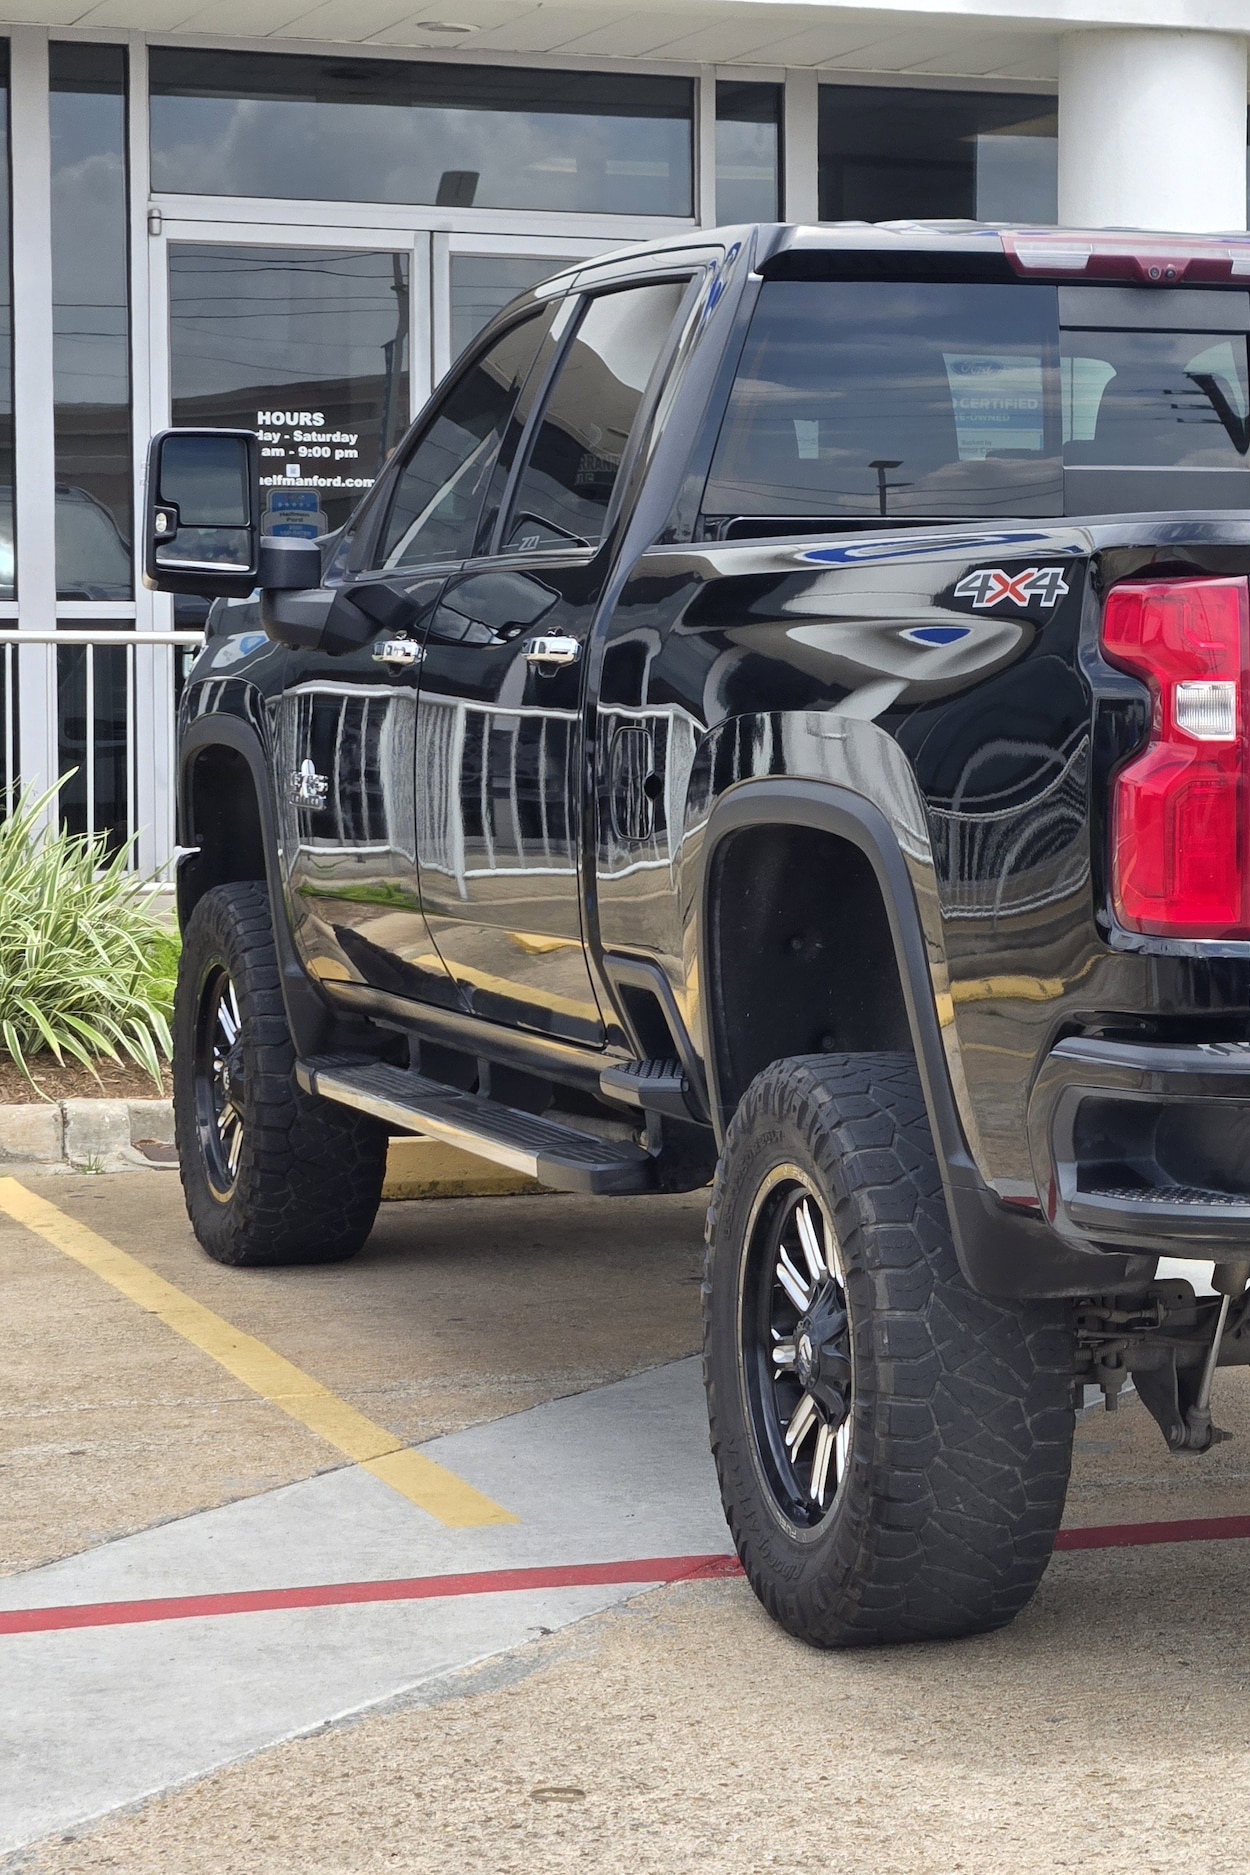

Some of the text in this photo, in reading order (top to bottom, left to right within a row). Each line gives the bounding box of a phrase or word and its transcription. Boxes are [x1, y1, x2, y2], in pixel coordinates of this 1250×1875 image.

[960, 397, 1037, 409] CERTIFIED
[257, 411, 325, 425] HOURS
[255, 430, 280, 443] day
[293, 430, 357, 444] Saturday
[261, 448, 284, 456] am
[298, 446, 330, 457] 9:00
[335, 448, 358, 459] pm
